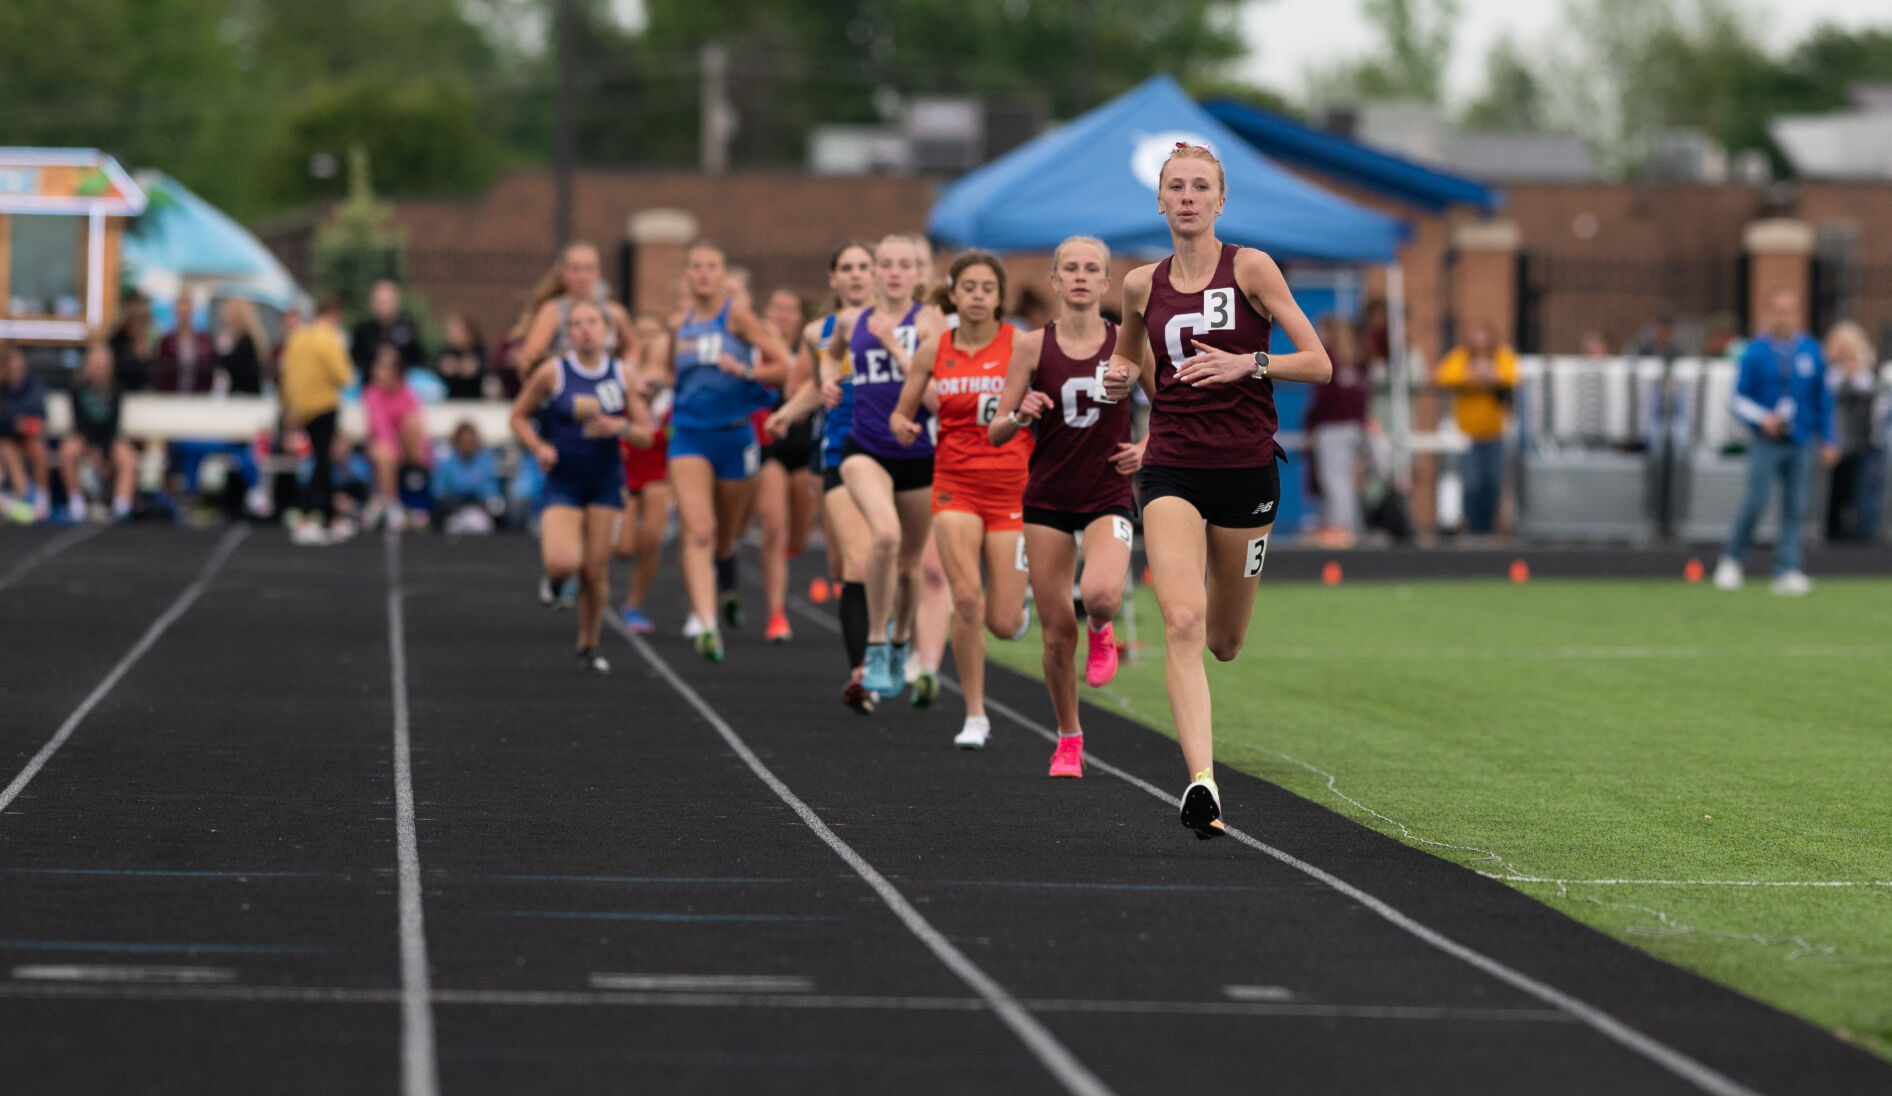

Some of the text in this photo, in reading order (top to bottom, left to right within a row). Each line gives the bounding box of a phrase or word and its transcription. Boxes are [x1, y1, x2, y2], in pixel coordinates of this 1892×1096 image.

[1210, 291, 1229, 329] 3
[1165, 312, 1210, 372] C
[936, 375, 1007, 396] ORTHRO
[1061, 376, 1101, 428] C
[983, 397, 998, 424] 6
[1119, 520, 1130, 542] 5
[1250, 539, 1265, 575] 3
